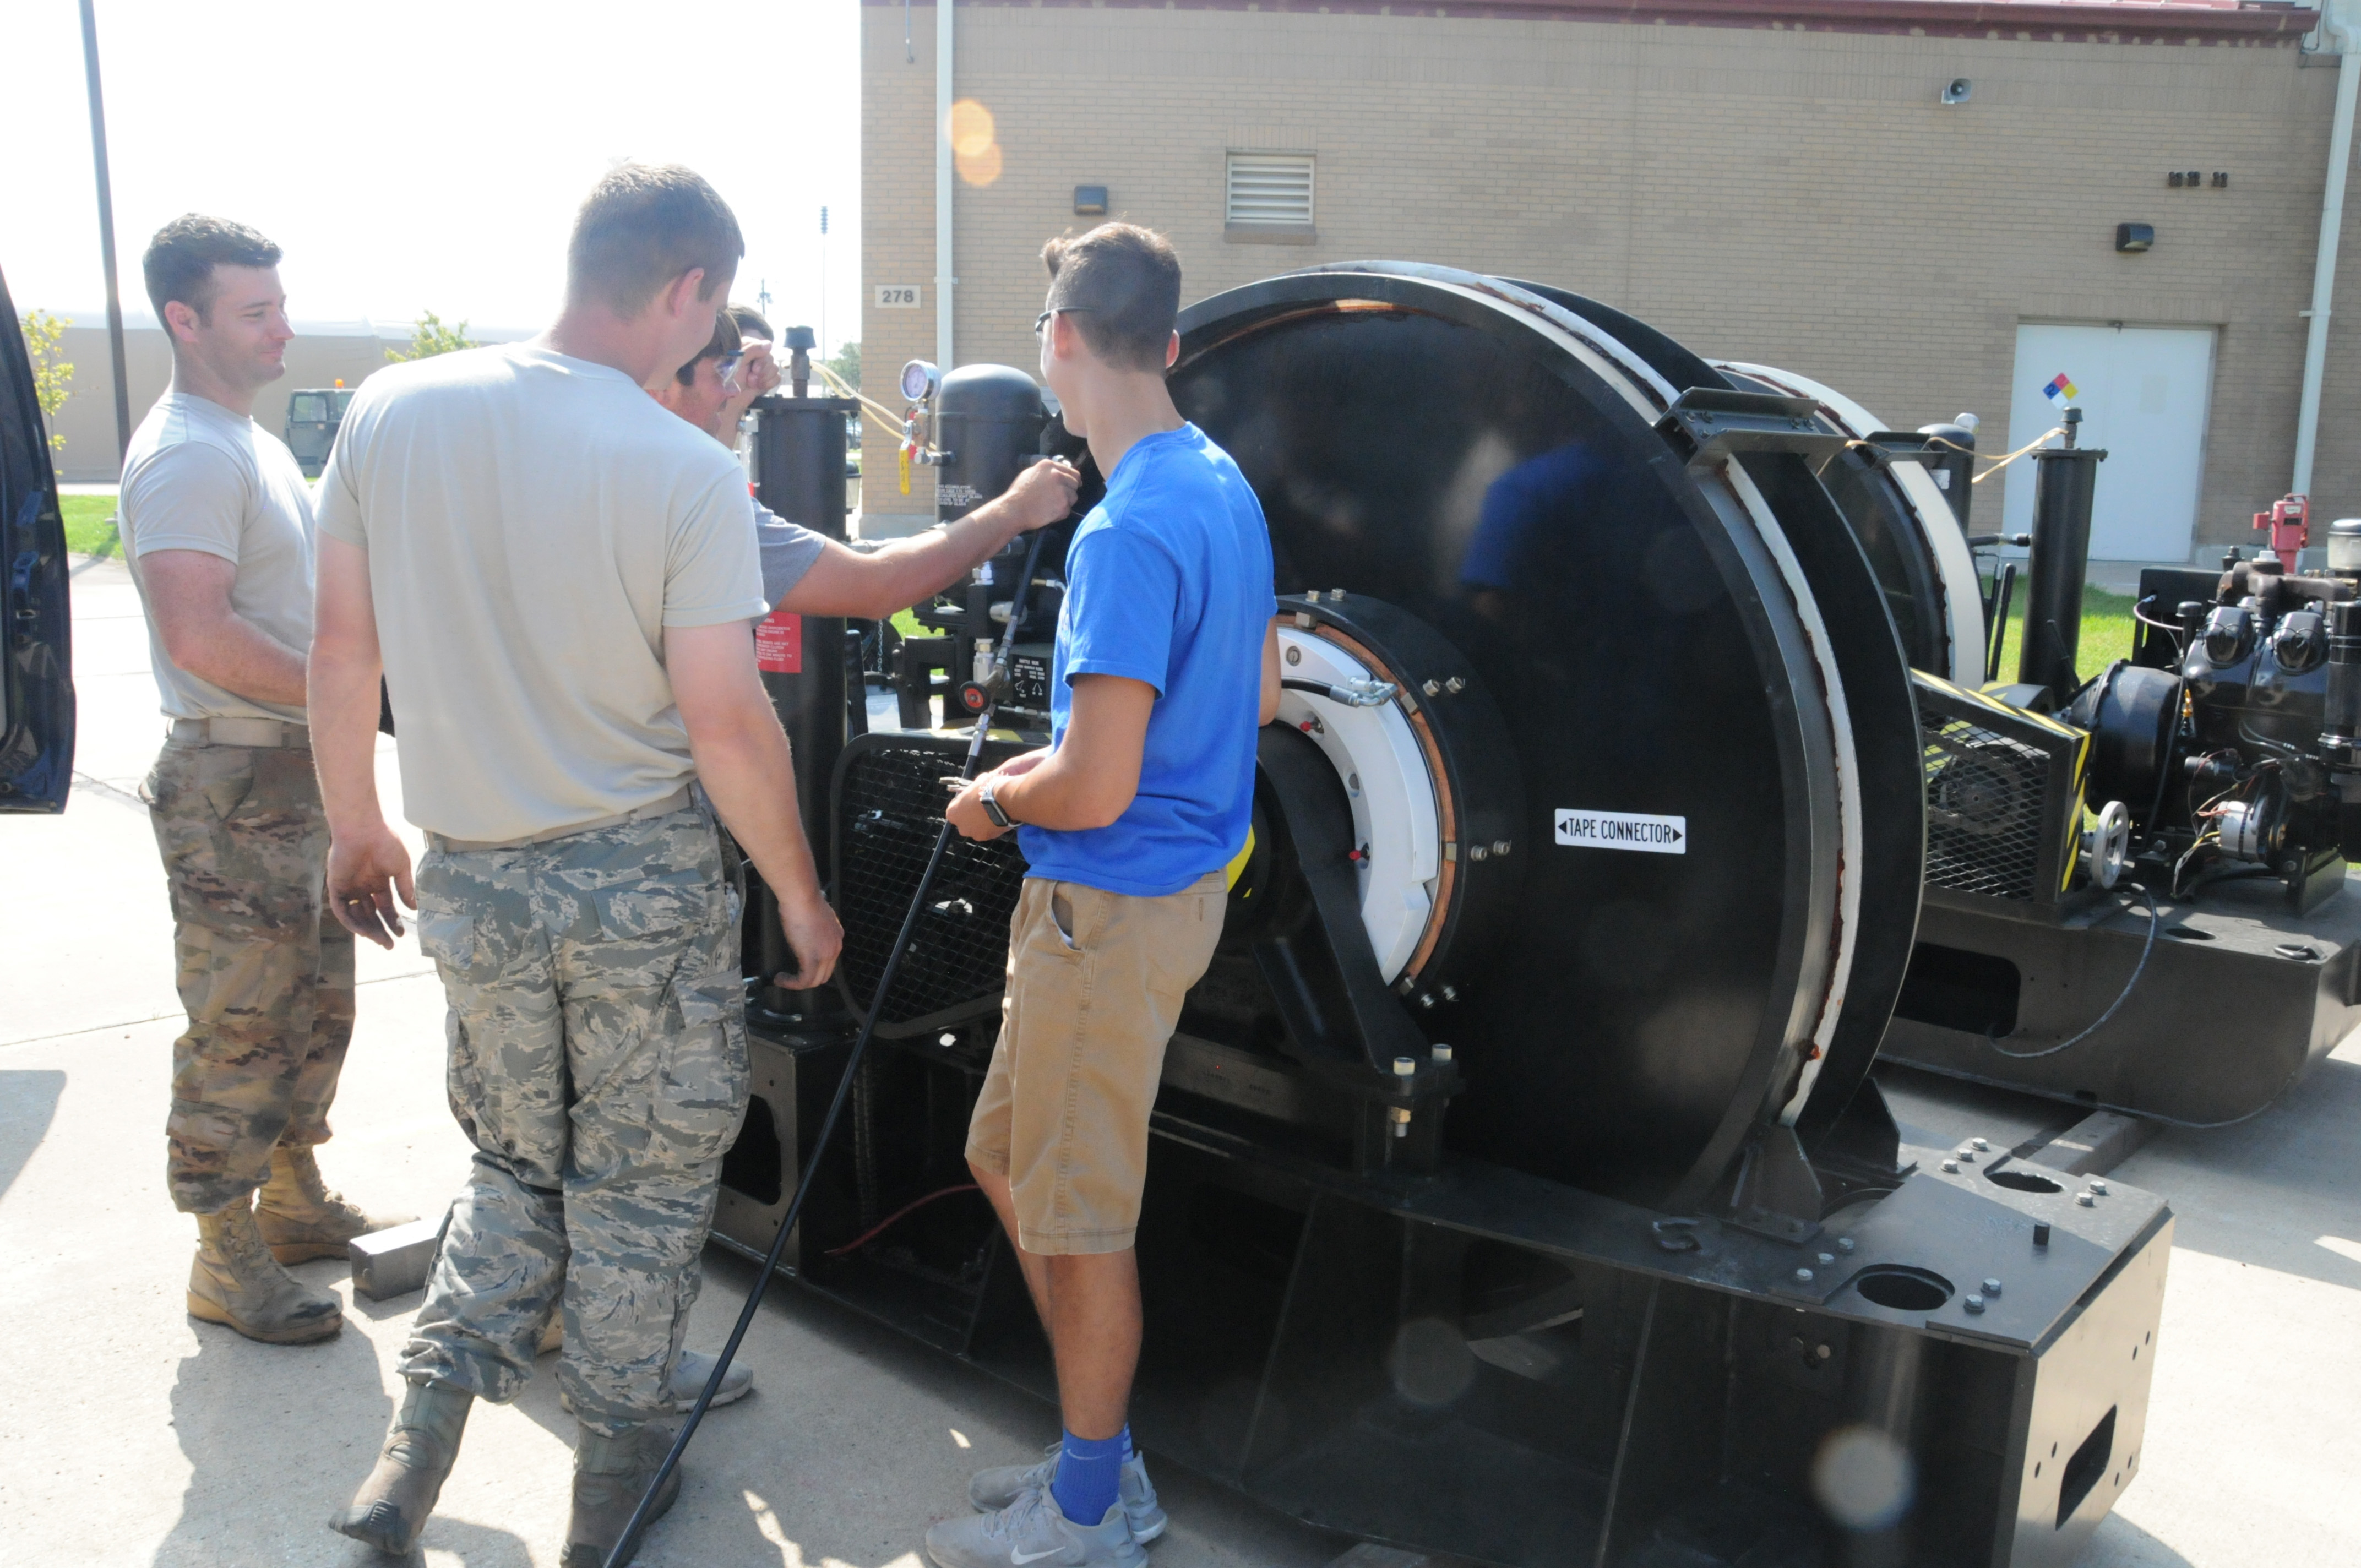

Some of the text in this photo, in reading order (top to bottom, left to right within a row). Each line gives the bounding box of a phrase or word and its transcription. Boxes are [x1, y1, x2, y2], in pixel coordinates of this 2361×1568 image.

[882, 290, 914, 303] 278
[2047, 384, 2055, 395] 2
[1569, 818, 1671, 844] TAPE CONNECTOR
